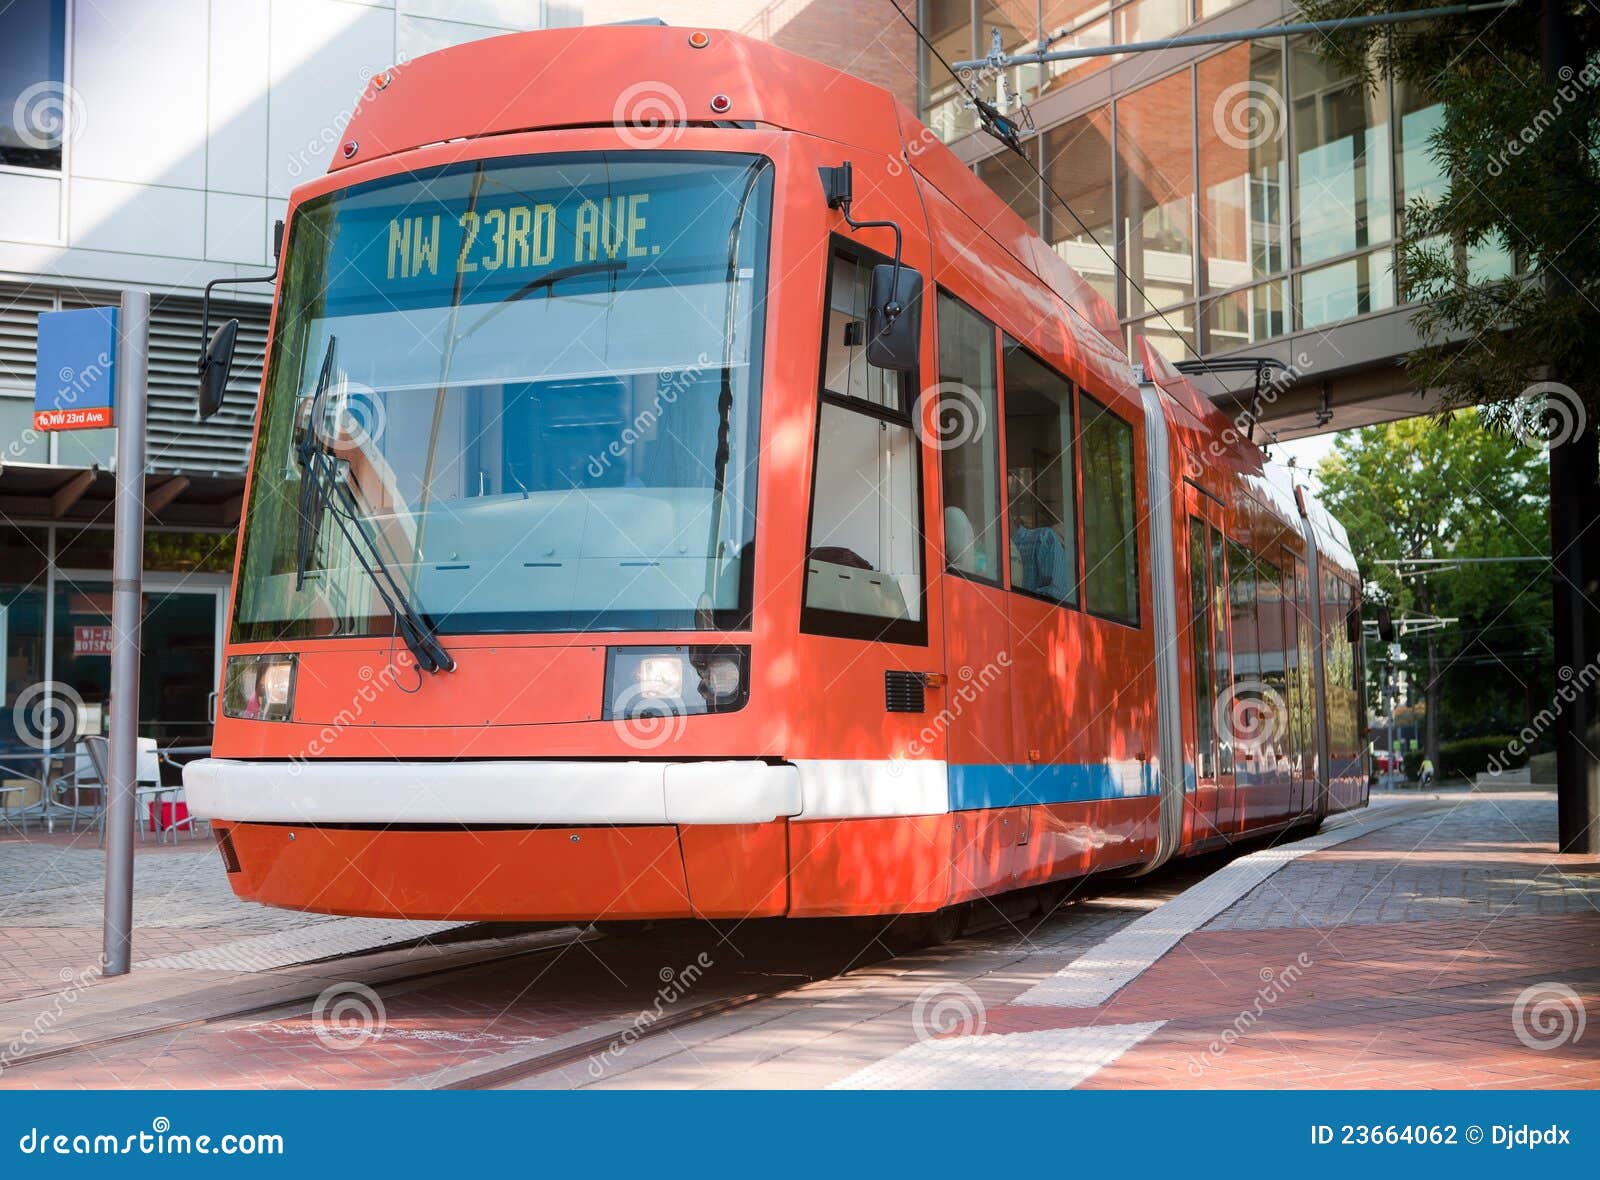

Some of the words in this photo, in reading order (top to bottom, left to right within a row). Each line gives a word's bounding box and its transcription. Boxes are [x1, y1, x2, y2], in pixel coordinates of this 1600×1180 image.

[387, 215, 441, 280] NW
[456, 203, 556, 273] 23RD
[574, 193, 661, 263] AVE.
[50, 414, 65, 424] NW
[66, 412, 85, 423] 23rd
[86, 411, 104, 422] Ave.
[75, 640, 112, 651] HOTSPO
